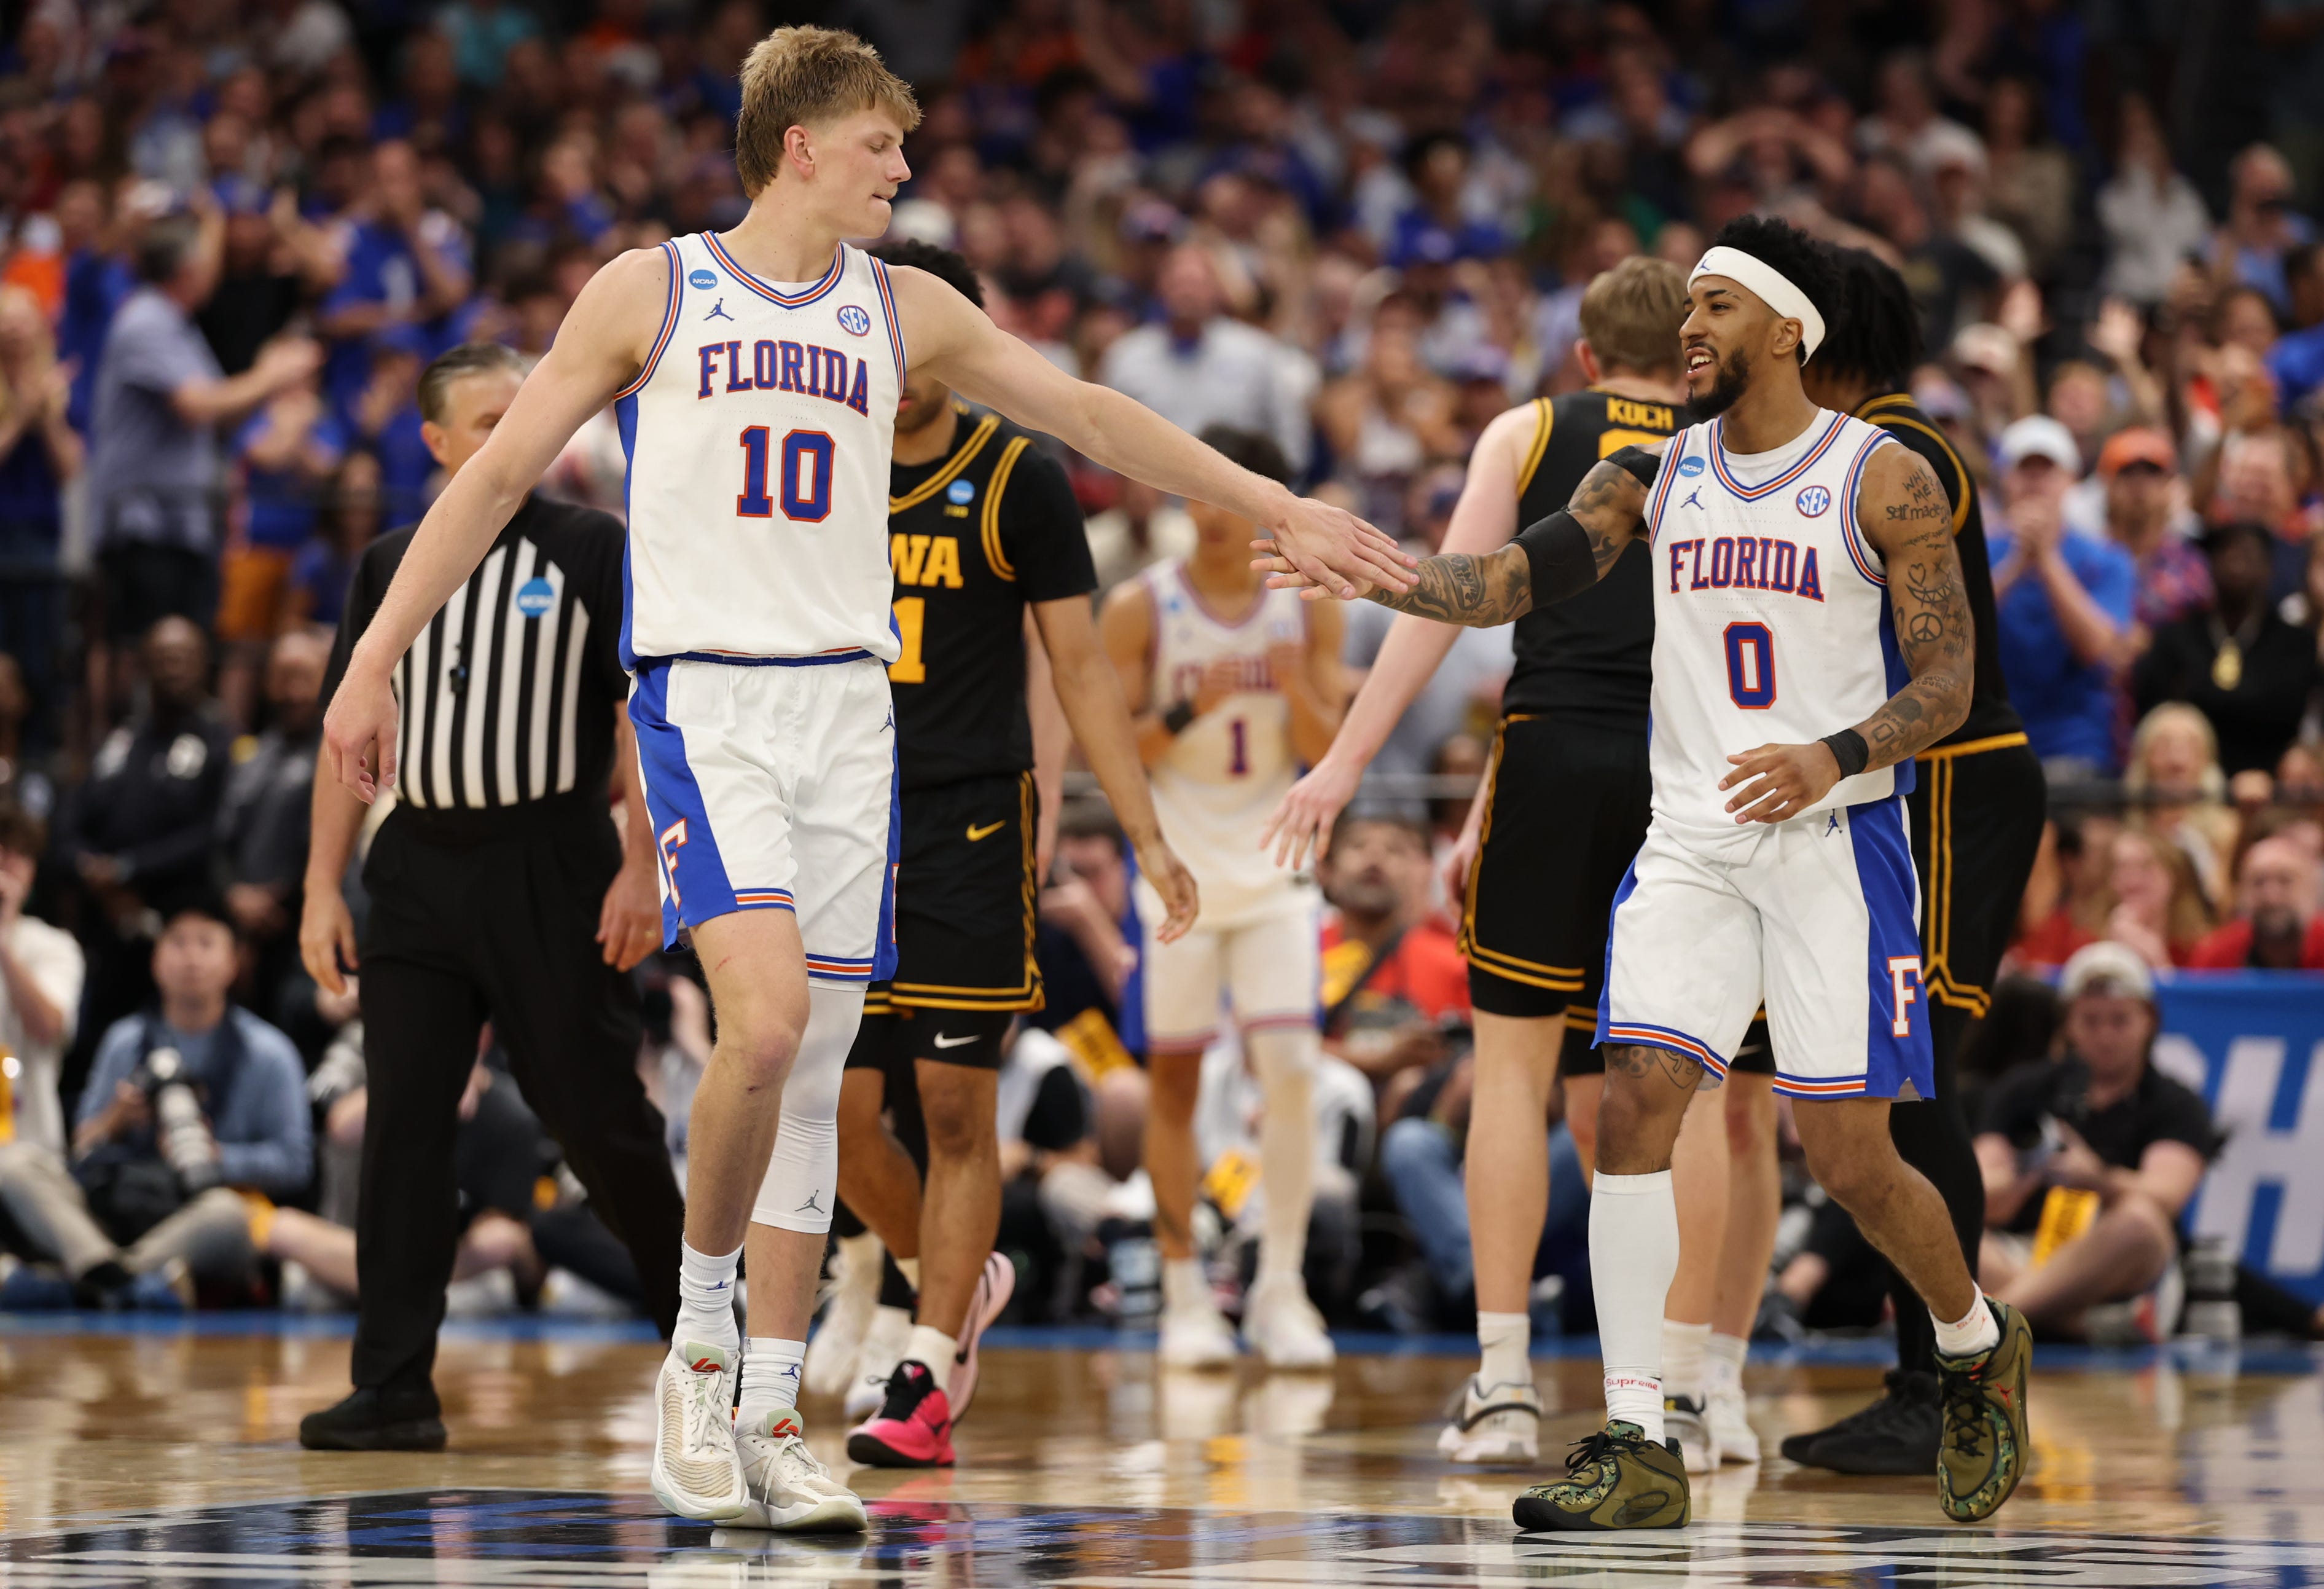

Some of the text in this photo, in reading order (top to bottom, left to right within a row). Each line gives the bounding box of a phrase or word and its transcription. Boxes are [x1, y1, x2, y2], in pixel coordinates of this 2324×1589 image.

[839, 307, 868, 335] SEC
[698, 340, 869, 418] FLORIDA
[1606, 396, 1674, 431] KOCH
[737, 425, 836, 524] 10
[1798, 488, 1829, 516] SEC
[1903, 466, 1928, 492] WHY
[890, 533, 964, 589] WA
[1669, 536, 1825, 603] FLORIDA
[1723, 622, 1777, 709] 0
[1887, 955, 1923, 1037] F
[1606, 1378, 1657, 1391] Supreme
